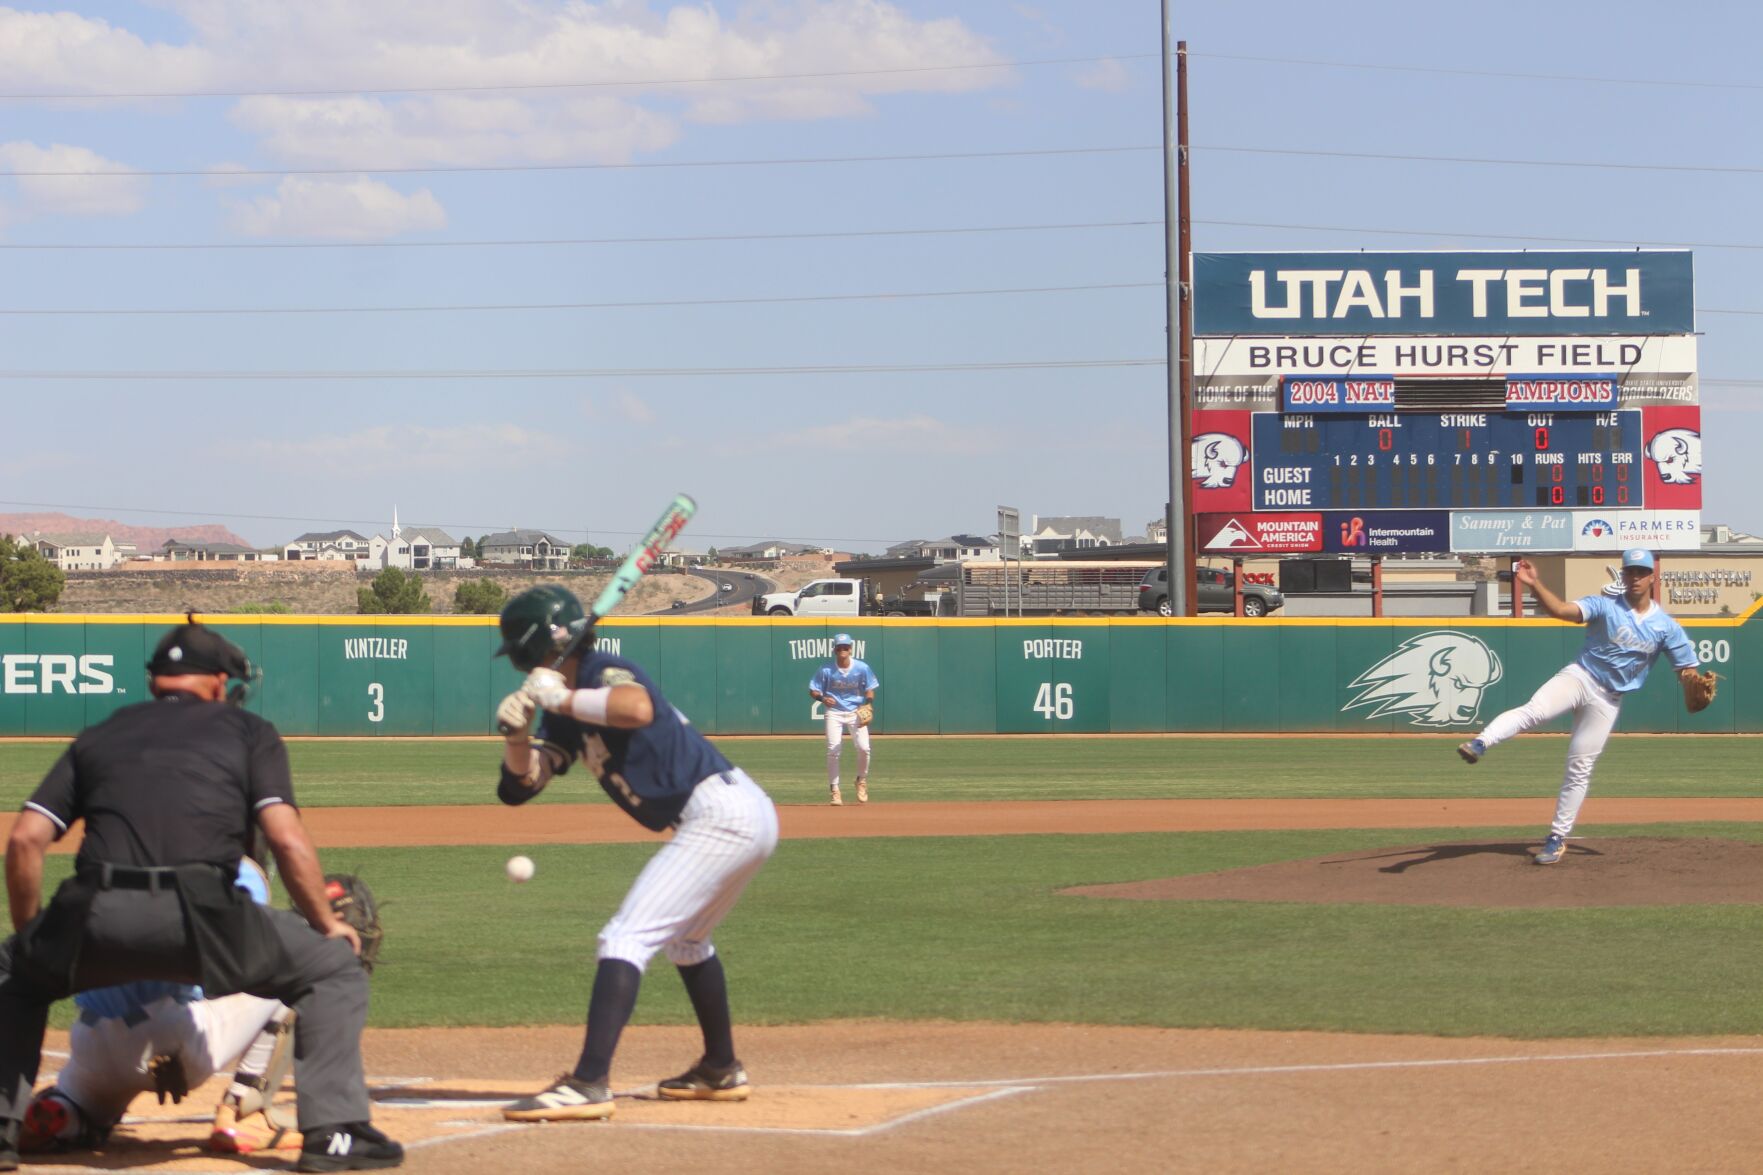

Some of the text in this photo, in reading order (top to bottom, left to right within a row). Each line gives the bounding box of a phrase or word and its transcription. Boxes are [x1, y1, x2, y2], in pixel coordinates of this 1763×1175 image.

[1248, 269, 1434, 319] UTAH
[1455, 268, 1641, 318] TECH
[1249, 344, 1642, 368] BRUCE HURST FIELD
[1197, 385, 1273, 403] HOME OF THE
[1290, 380, 1394, 404] 2004 NAT
[1505, 380, 1612, 403] AMPIONS
[1616, 384, 1693, 402] TRAILBLAZERS
[1284, 412, 1619, 428] MPH BALL STRIKE OUT H/E
[1379, 428, 1393, 451] 0
[1465, 430, 1471, 449] 1
[1535, 427, 1549, 450] 0
[1334, 453, 1633, 466] 1 2 3 4 5 6 7 8 9 10 RUNS HITS ERR
[1263, 467, 1312, 484] GUEST
[1552, 464, 1563, 482] 0
[1264, 489, 1312, 505] HOME
[1552, 486, 1564, 504] 0
[1592, 486, 1604, 504] 0
[1617, 485, 1629, 503] 0
[1257, 521, 1319, 532] MOUNTAIN
[1459, 514, 1566, 531] Sammy & Pat
[1620, 520, 1695, 531] FARMERS
[1261, 532, 1315, 543] AMERICA
[1368, 528, 1434, 537] Intermountain
[1496, 532, 1532, 546] Irvin
[1620, 533, 1671, 541] INSURANCE
[1368, 538, 1398, 546] Health
[344, 637, 408, 660] KINTZLER
[593, 637, 621, 657] YON
[789, 638, 866, 660] THOMPON
[1023, 638, 1082, 660] PORTER
[0, 654, 114, 694] ERS
[367, 682, 385, 722] 3
[1033, 682, 1074, 720] 46
